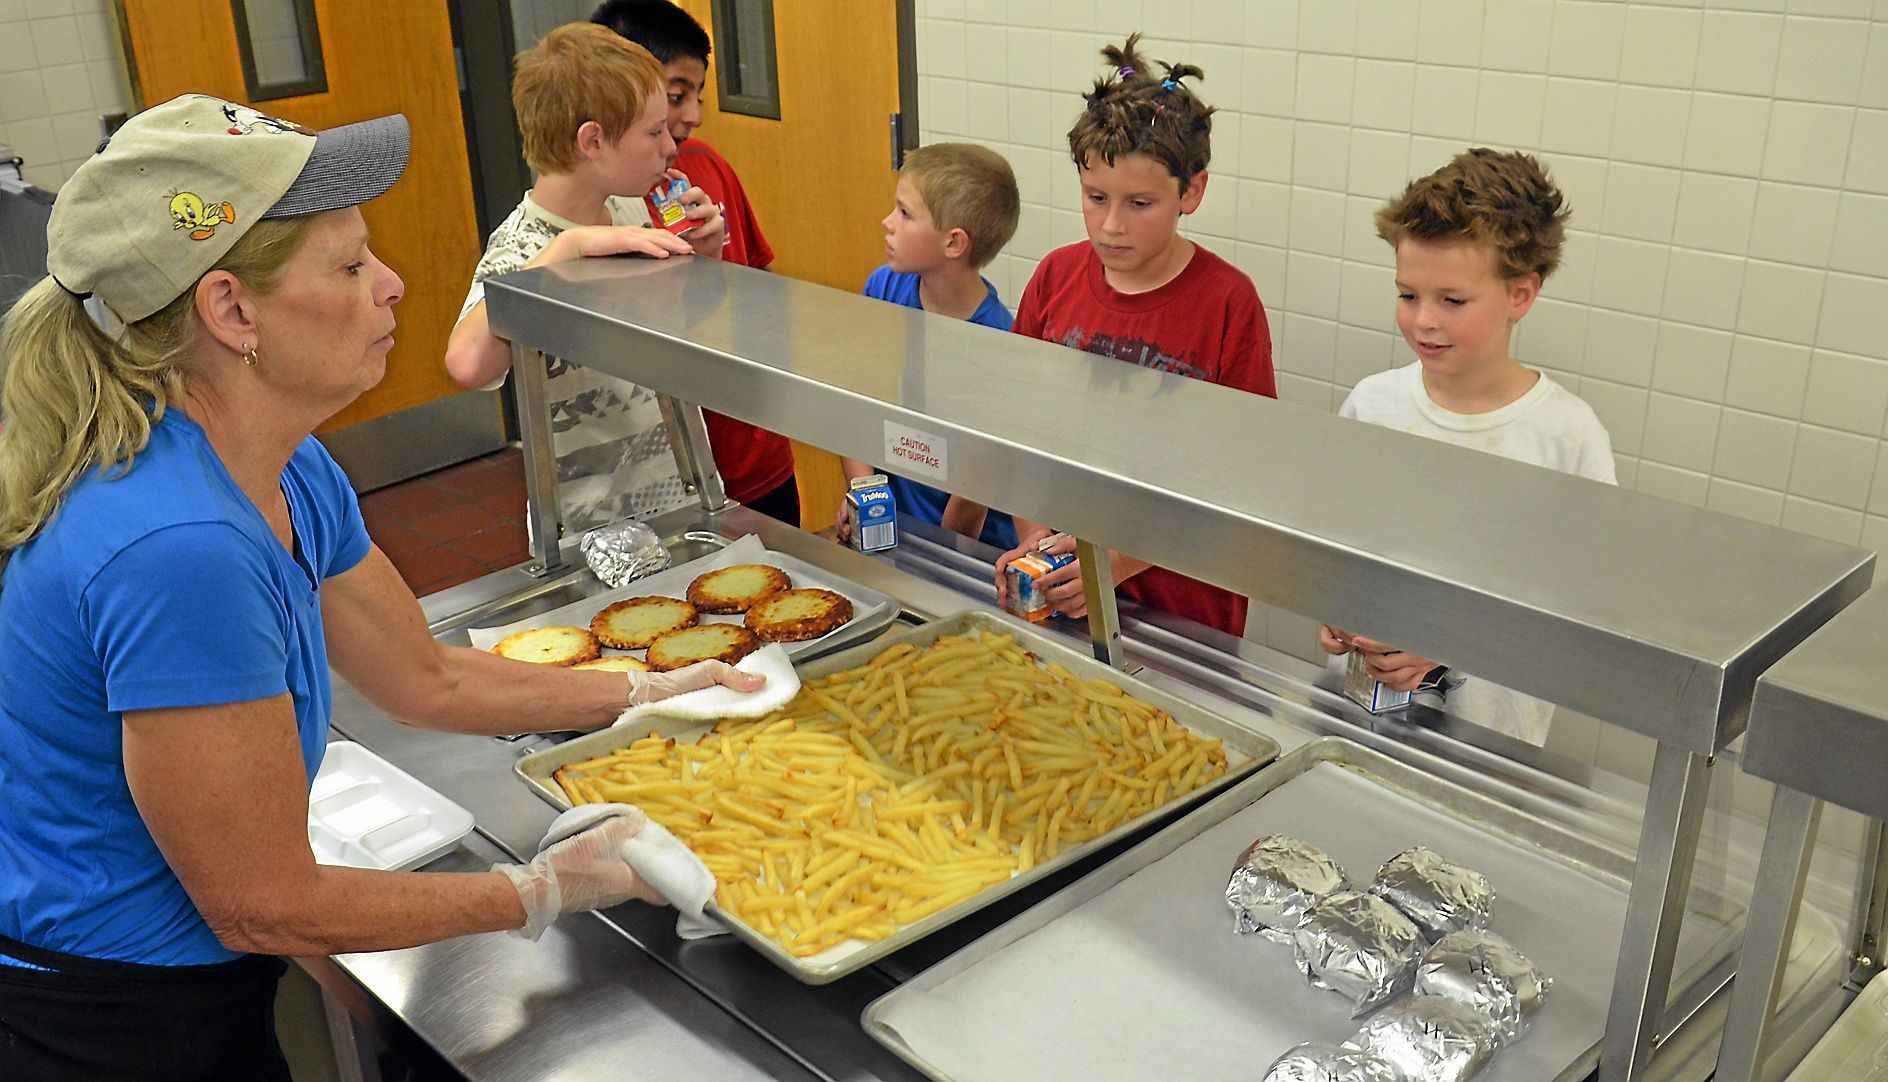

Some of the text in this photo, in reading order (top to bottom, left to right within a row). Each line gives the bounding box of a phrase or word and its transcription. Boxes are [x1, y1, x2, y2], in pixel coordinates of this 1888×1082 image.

[900, 436, 931, 452] CAUTION
[892, 445, 939, 468] HOT SURFACE
